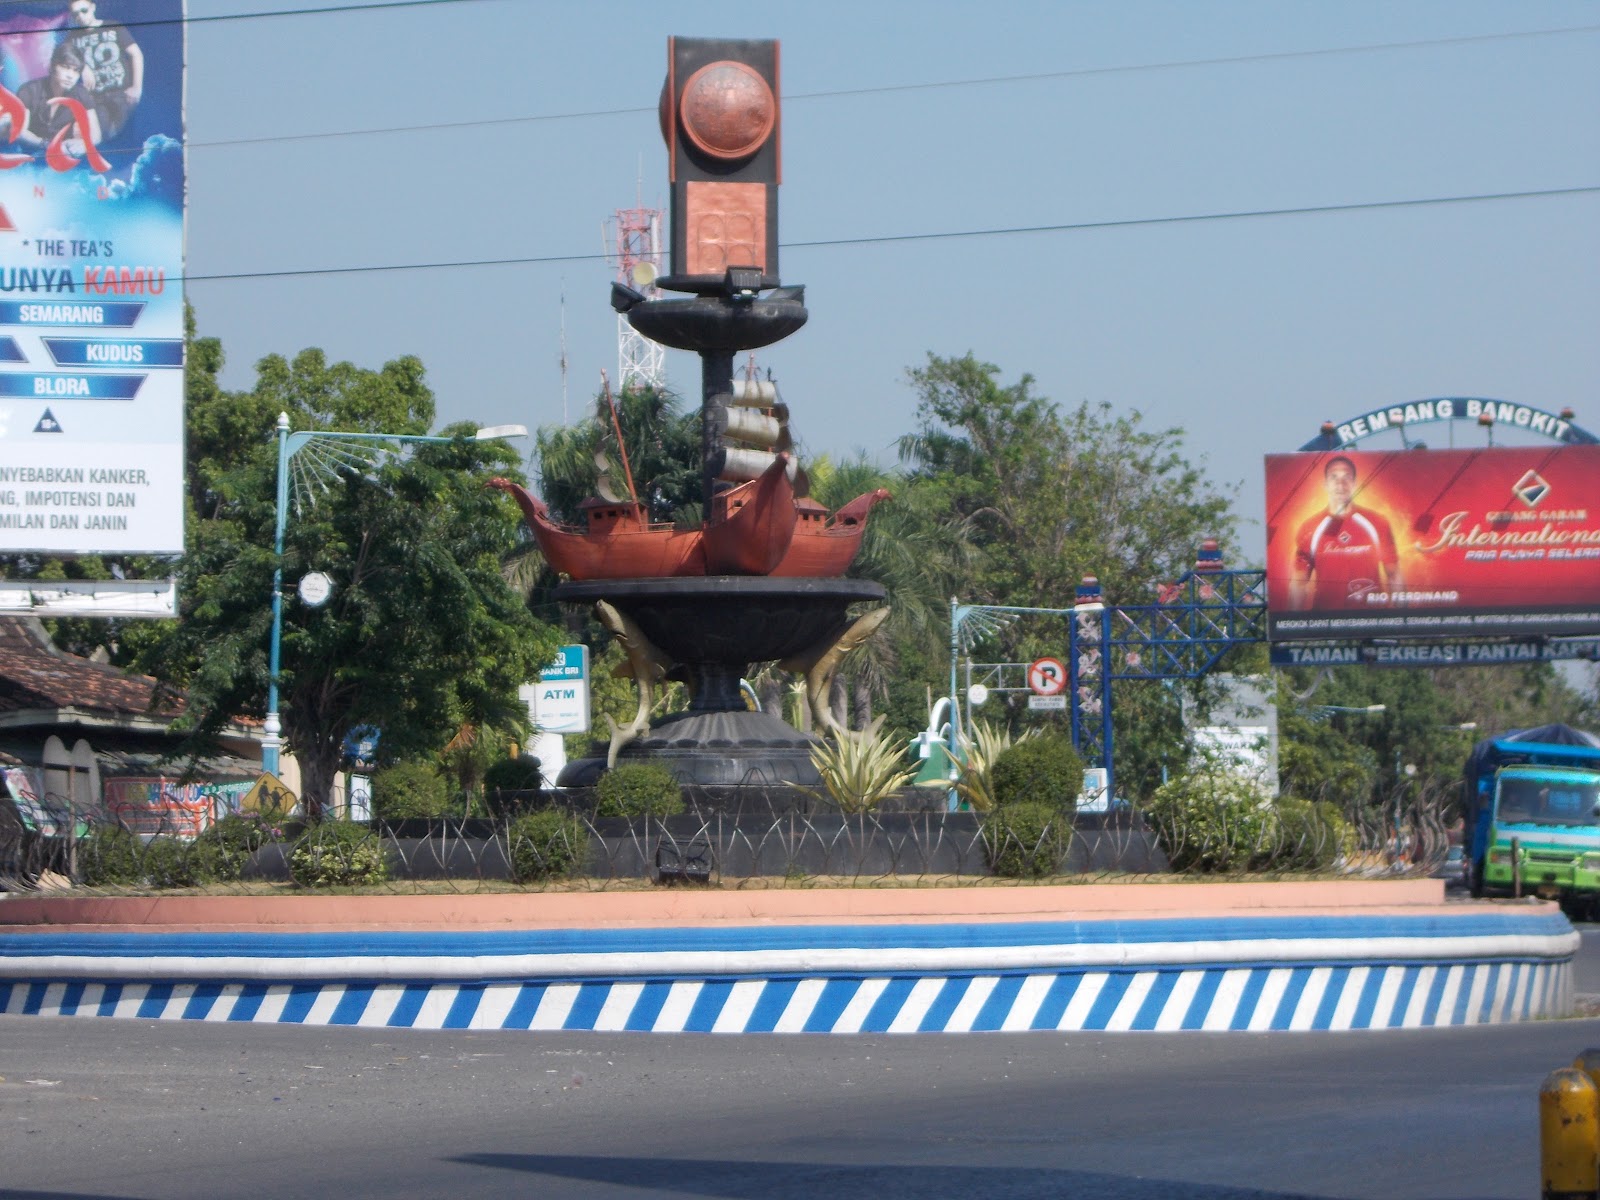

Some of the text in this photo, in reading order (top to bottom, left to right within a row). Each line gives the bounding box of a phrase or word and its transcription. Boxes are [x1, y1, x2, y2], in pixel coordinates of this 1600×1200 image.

[36, 239, 113, 258] THE TEA'S
[84, 266, 165, 295] KAMU
[20, 304, 104, 323] SEMARANG
[86, 344, 143, 362] KUDUS
[34, 377, 90, 395] BLORA
[1466, 400, 1570, 438] BANGKIT
[89, 468, 150, 486] KANKER,
[25, 491, 101, 507] IMPOTENSI
[106, 492, 135, 508] DAN
[50, 514, 79, 529] DAN
[84, 515, 127, 530] JANIN
[1366, 591, 1458, 603] RIO FERDINAND
[1289, 648, 1358, 662] TAMAN
[1364, 645, 1461, 661] EKREASI
[1467, 643, 1537, 659] PANTAI
[565, 666, 579, 675] BRI
[543, 689, 575, 700] ATM
